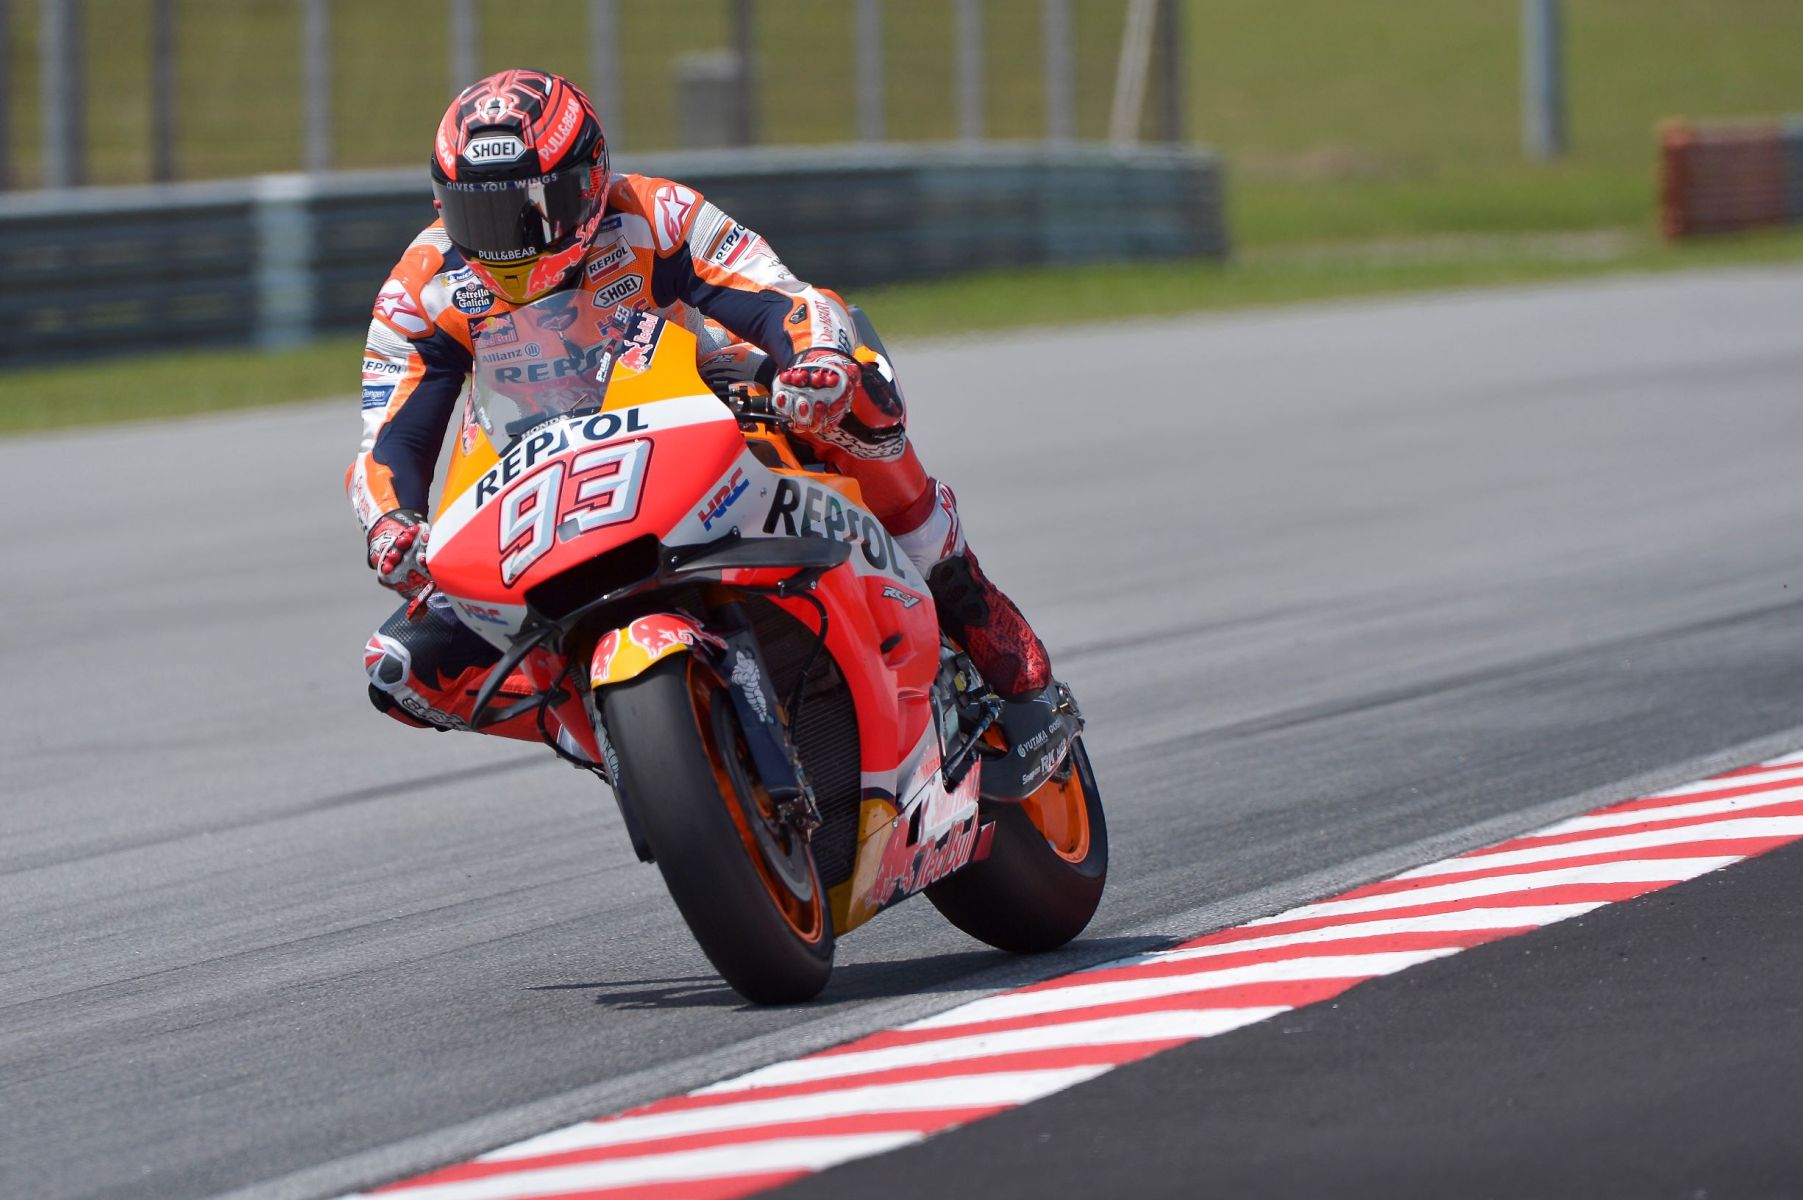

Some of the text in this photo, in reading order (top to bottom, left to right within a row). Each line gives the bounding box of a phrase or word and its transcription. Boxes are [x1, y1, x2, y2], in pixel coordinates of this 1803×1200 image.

[539, 98, 580, 161] PULL&BEAR
[472, 141, 516, 158] SHOEI
[446, 172, 558, 193] GIVES YOU WINGS
[478, 246, 537, 261] PULL&BEAR
[588, 246, 628, 275] REPSOL
[455, 288, 490, 300] Estrella
[458, 298, 490, 309] Galicia
[598, 277, 638, 306] SHOEI
[614, 304, 630, 324] 93
[482, 348, 522, 363] Allianz
[521, 414, 569, 440] HONDA
[475, 407, 649, 510] REPSOL
[696, 467, 750, 531] HRC
[498, 436, 655, 589] 93
[762, 478, 906, 580] REPSOL
[1022, 730, 1048, 752] YUTAKA
[1040, 748, 1056, 774] RK
